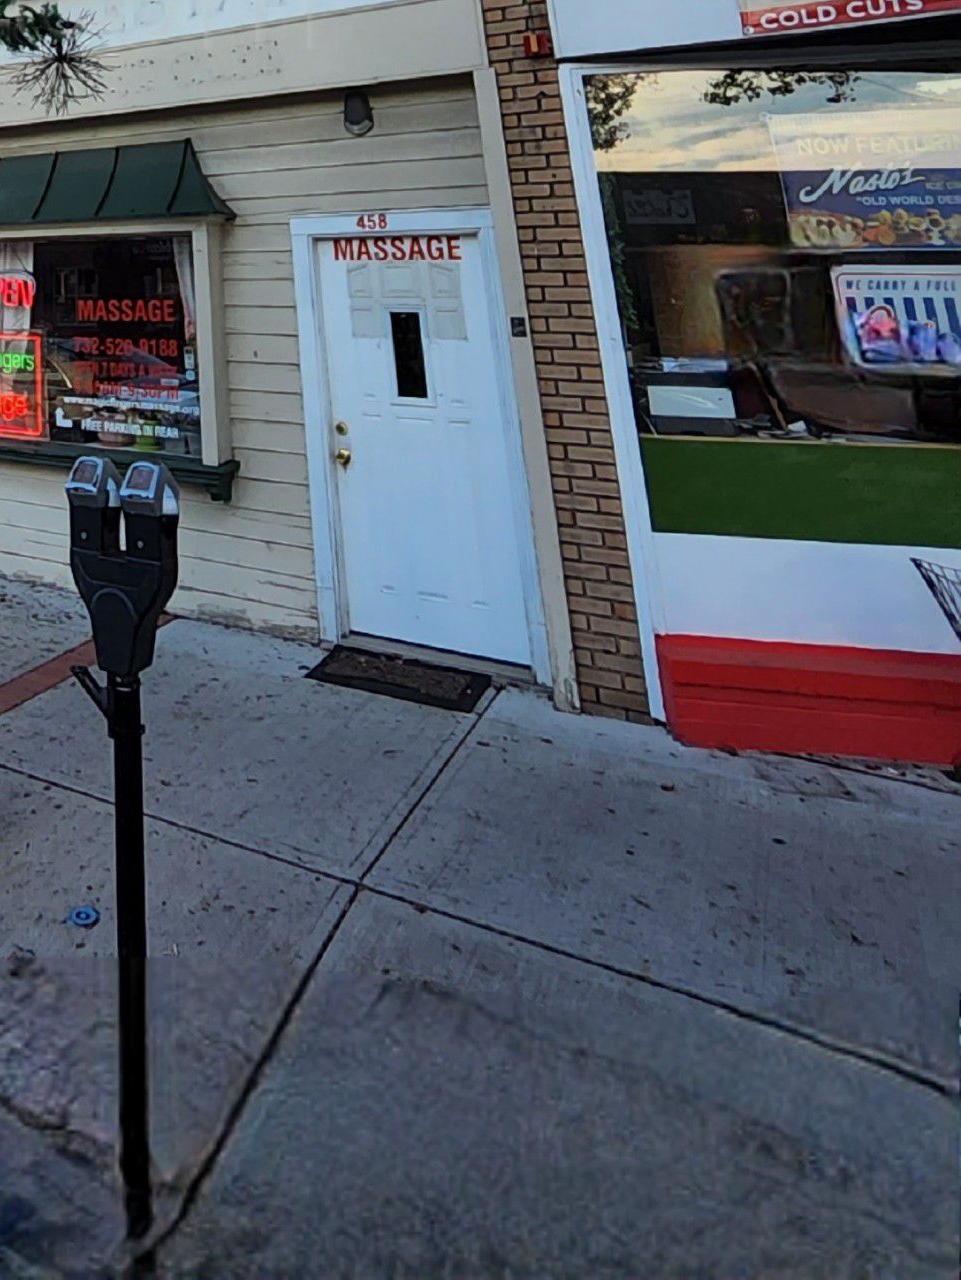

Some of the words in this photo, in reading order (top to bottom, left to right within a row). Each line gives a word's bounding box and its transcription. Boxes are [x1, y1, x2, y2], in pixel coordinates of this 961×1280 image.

[759, 5, 837, 29] COLD
[796, 136, 849, 156] NOW
[890, 195, 934, 205] WORLD
[356, 213, 388, 230] 458
[333, 235, 462, 261] MASSAGE
[846, 280, 861, 290] WE
[867, 280, 906, 290] CARRY
[913, 280, 920, 291] A
[77, 298, 175, 322] MASSAGE
[81, 419, 102, 431] FREE
[104, 421, 141, 436] PARKING
